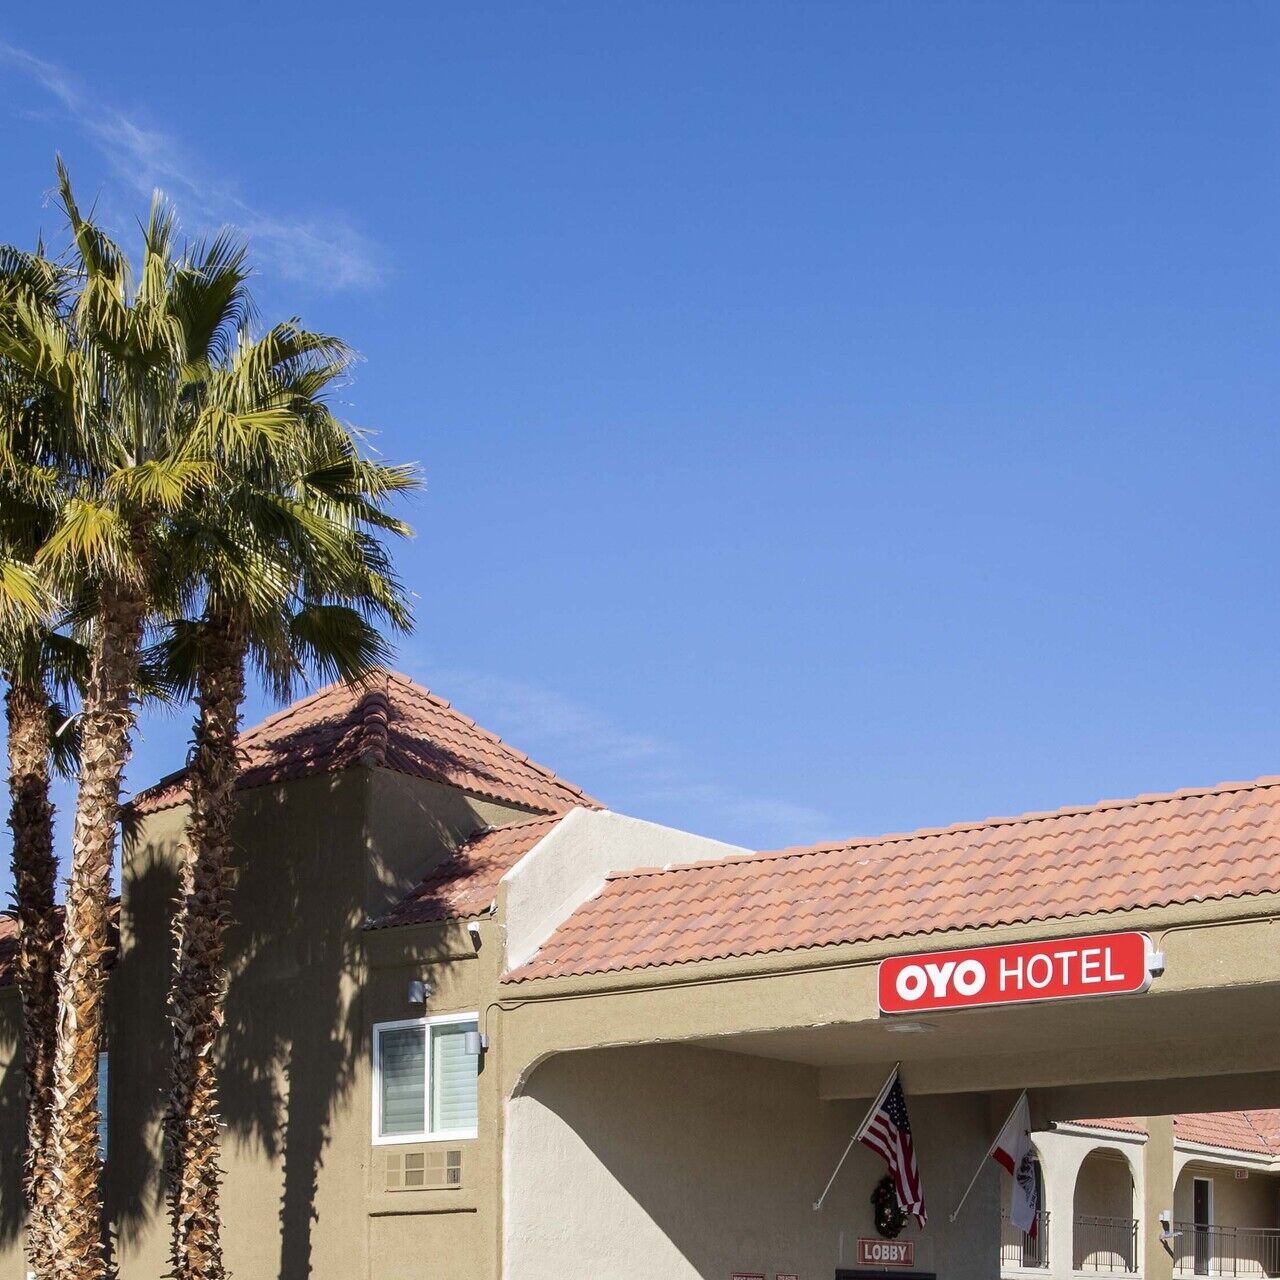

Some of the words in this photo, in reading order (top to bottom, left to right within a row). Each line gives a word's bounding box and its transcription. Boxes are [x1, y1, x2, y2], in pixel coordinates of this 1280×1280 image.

[895, 959, 986, 1001] OYO
[999, 947, 1125, 991] HOTEL
[864, 1244, 907, 1261] LOBBY
